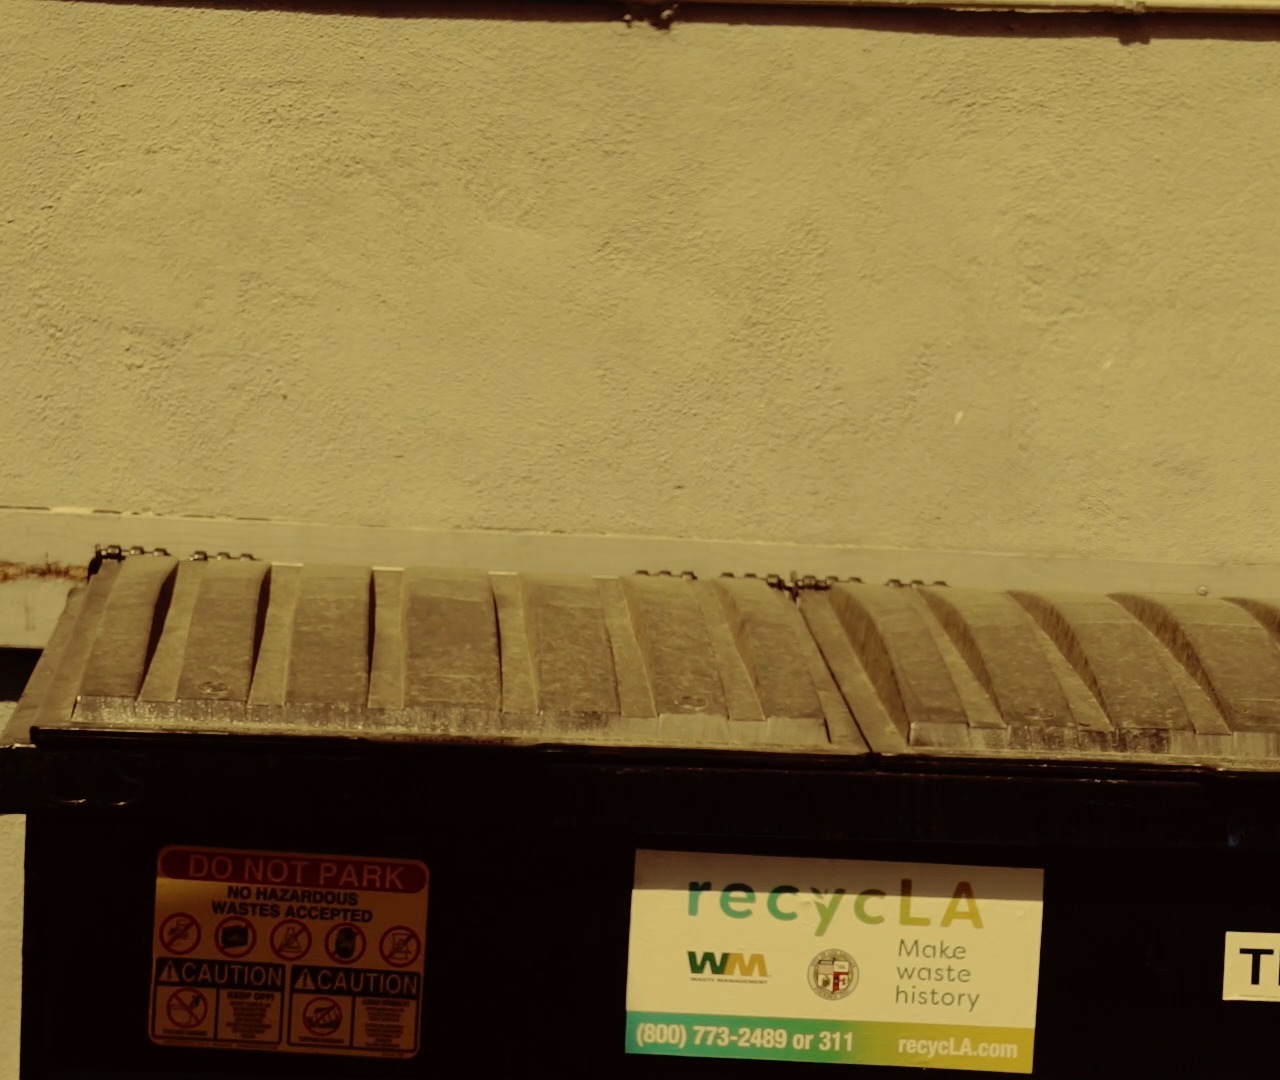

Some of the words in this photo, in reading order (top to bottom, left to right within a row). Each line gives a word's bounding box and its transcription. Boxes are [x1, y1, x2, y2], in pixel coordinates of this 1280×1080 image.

[189, 853, 233, 880] DO
[244, 857, 310, 884] NOT
[320, 862, 406, 890] PARK
[227, 885, 251, 900] NO
[256, 887, 359, 906] HAZARDOUS
[211, 901, 280, 917] WASTES
[284, 906, 373, 923] ACCEPTED
[687, 878, 984, 937] recycLA
[898, 939, 967, 960] Make
[181, 963, 283, 987] CAUTION
[687, 951, 769, 978] WM
[897, 965, 972, 983] waste
[316, 972, 419, 995] CAUTION
[895, 986, 980, 1012] history
[637, 1024, 687, 1048] (800)
[692, 1026, 788, 1049] 773-2489
[792, 1034, 814, 1050] or
[819, 1032, 854, 1052] 311
[898, 1037, 1018, 1059] recycLA.com
